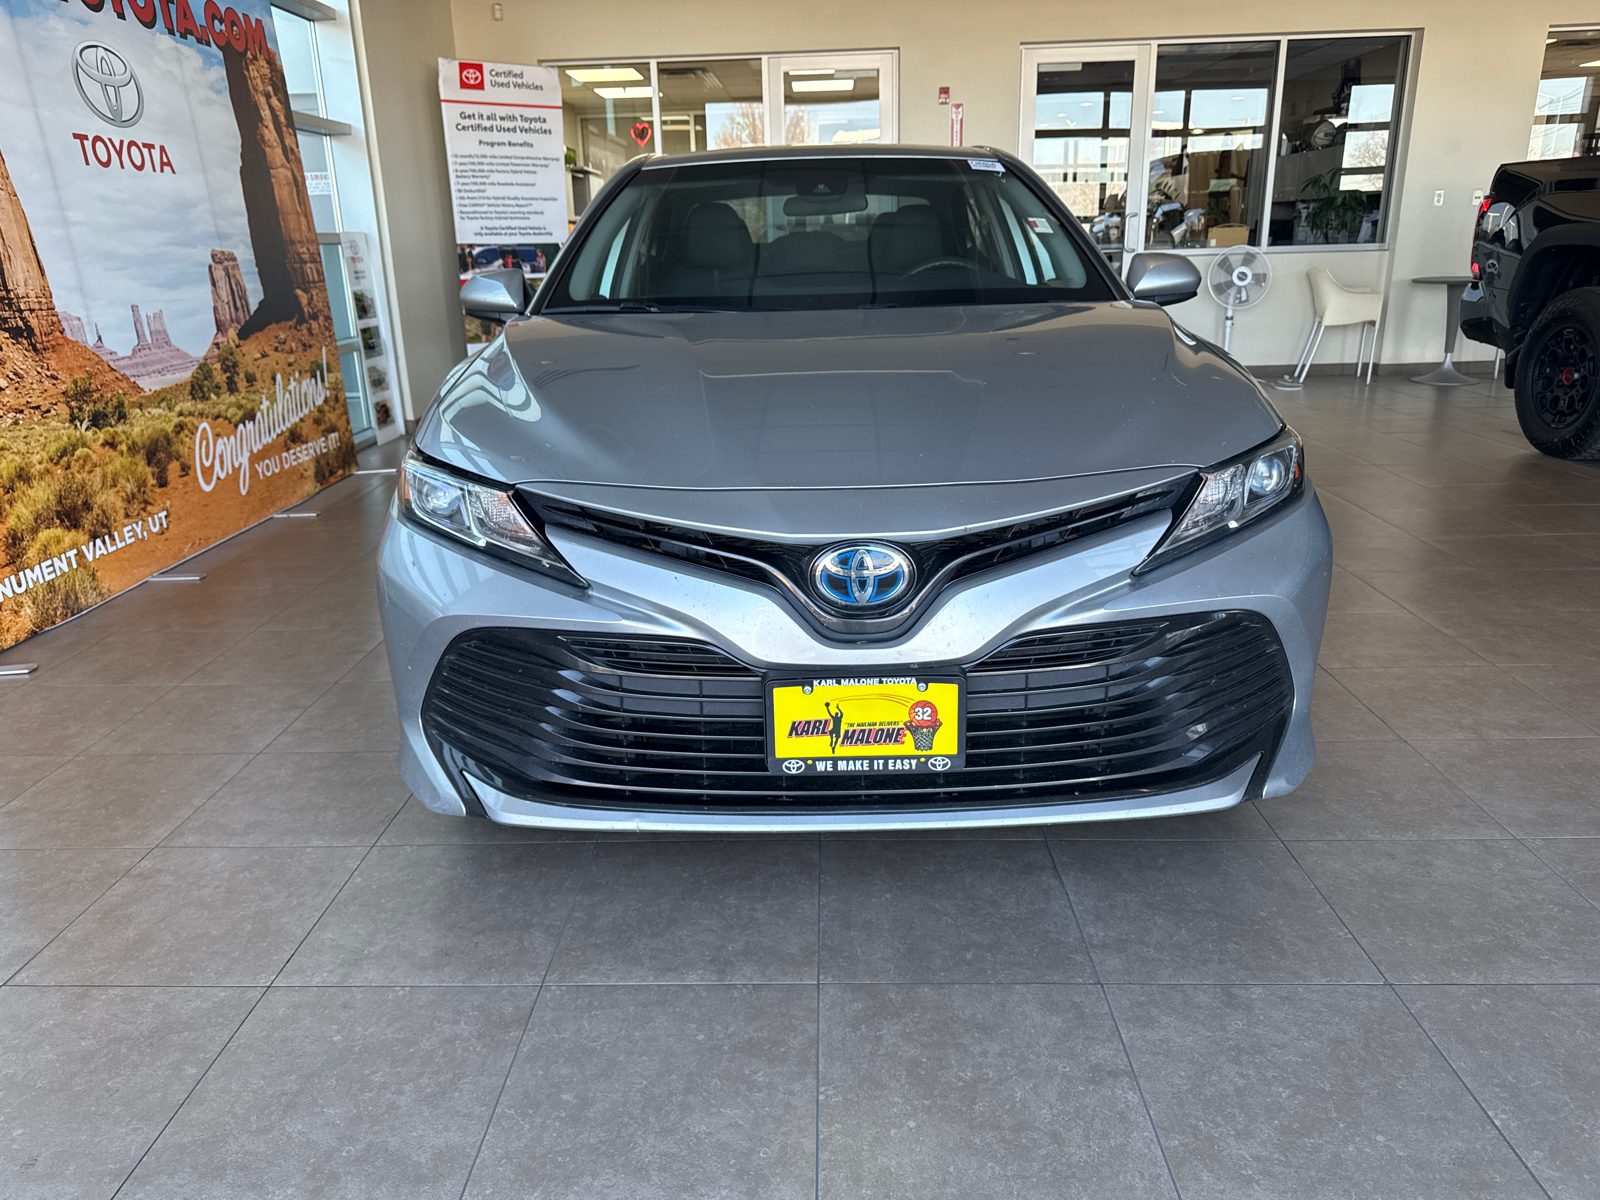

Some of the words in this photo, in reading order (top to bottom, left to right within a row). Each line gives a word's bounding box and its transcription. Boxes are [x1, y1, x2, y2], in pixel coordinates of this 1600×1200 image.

[62, 0, 270, 60] TA.COM
[489, 68, 524, 79] Certified
[490, 80, 510, 88] Used
[512, 80, 544, 92] Vehicles
[459, 111, 476, 120] Get
[477, 112, 484, 120] it
[486, 112, 497, 122] all
[498, 113, 518, 122] with
[519, 114, 547, 125] Toyota
[455, 122, 494, 132] Certified
[496, 124, 518, 134] Used
[518, 126, 552, 136] Vehicles
[478, 139, 506, 148] Program
[508, 140, 534, 148] Benefits
[72, 132, 177, 175] TOYOTA
[195, 346, 330, 496] Congratulations!
[255, 458, 282, 480] YOU
[282, 443, 328, 470] DESERVE
[328, 432, 342, 454] IT!
[80, 520, 148, 562] VALLEY,
[148, 510, 168, 533] UT
[840, 678, 880, 686] MALONE
[914, 706, 932, 720] 32
[787, 718, 832, 738] KARL
[840, 726, 906, 747] MALONE
[816, 760, 834, 772] WE
[838, 760, 870, 771] MAKE
[874, 760, 884, 770] IT
[888, 758, 918, 770] EASY
